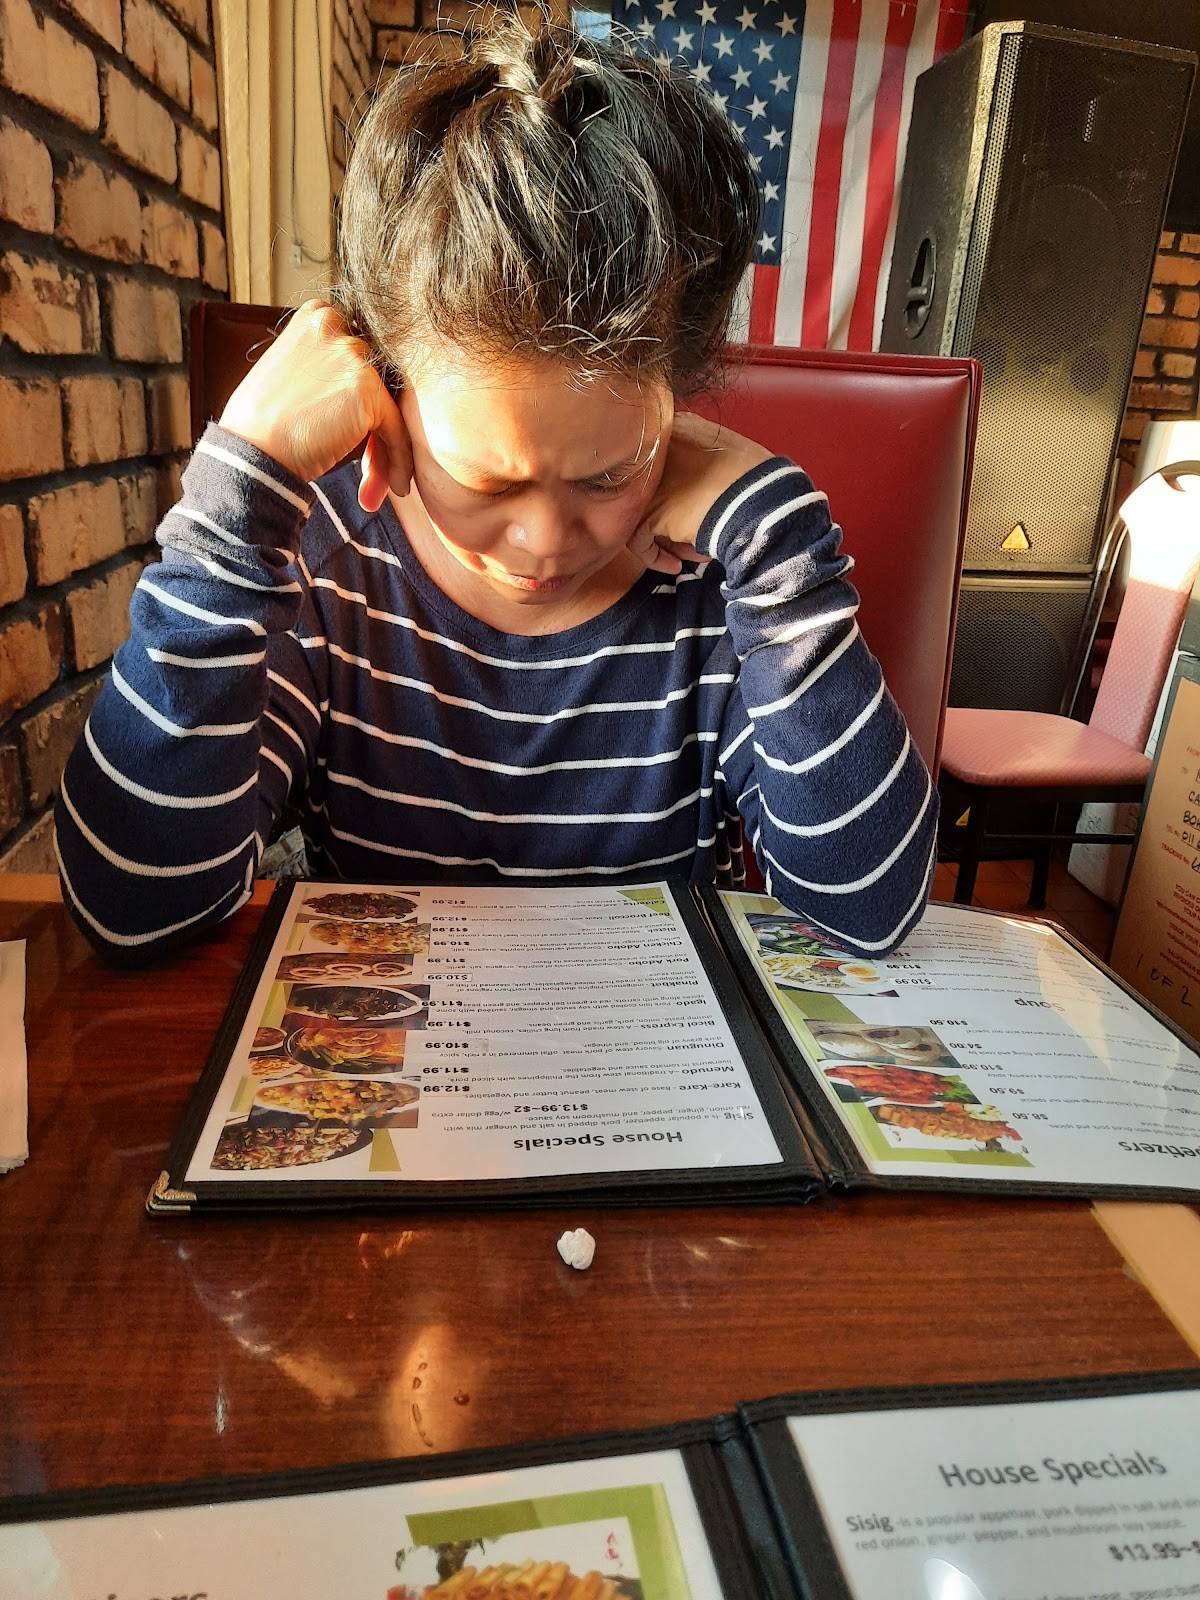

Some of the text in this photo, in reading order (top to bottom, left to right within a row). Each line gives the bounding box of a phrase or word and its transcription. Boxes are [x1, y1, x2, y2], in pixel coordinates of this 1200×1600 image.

[643, 940, 682, 948] Chicken
[1014, 998, 1065, 1012] Soup
[667, 1042, 724, 1051] Dinuguan
[682, 1066, 734, 1075] Menudo
[423, 1085, 470, 1093] $12.99
[679, 1082, 741, 1091] Kare-Kare
[989, 1087, 1024, 1095] $9.50
[640, 1108, 672, 1116] pepper,
[625, 1116, 665, 1124] appetizer,
[513, 1131, 683, 1150] House Specials
[938, 1448, 1167, 1488] House Specials
[846, 1513, 893, 1533] Sisig
